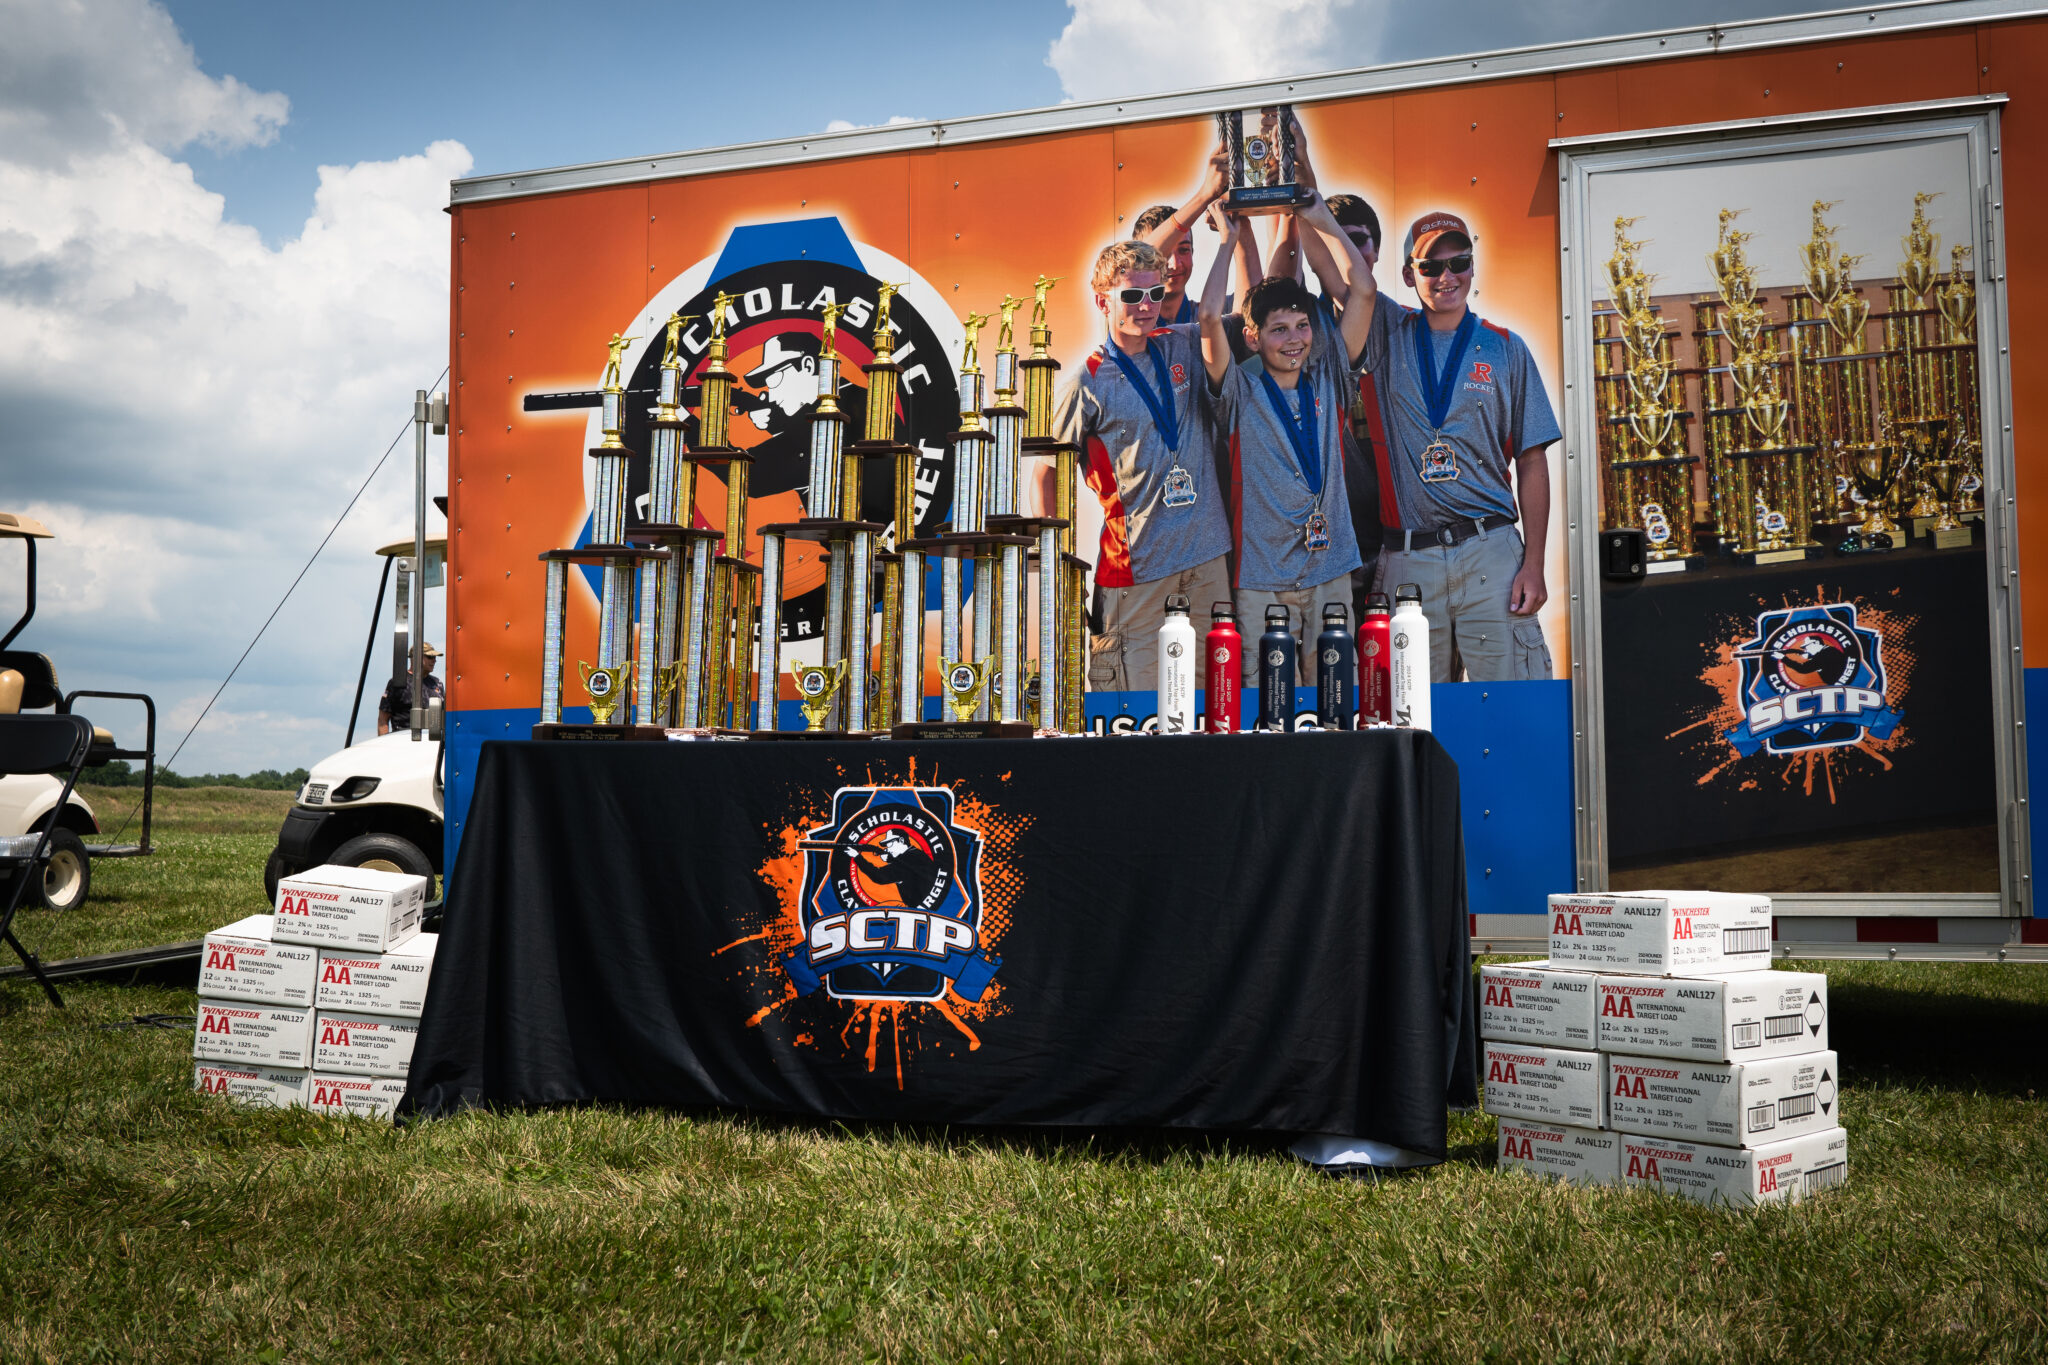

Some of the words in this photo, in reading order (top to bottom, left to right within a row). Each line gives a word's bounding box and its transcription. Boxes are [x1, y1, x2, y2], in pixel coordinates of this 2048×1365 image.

[1473, 362, 1492, 383] R
[1463, 382, 1495, 394] ROCKET
[1773, 624, 1852, 650] SCHOLASTIC
[1749, 687, 1882, 733] SCTP
[848, 811, 944, 854] SCHOLASTIC
[281, 888, 340, 902] WINCHESTER
[349, 896, 383, 906] AANL127
[278, 896, 309, 916] AA
[312, 905, 356, 914] INTERNATIONAL
[1551, 904, 1613, 915] WINCHESTER
[1624, 907, 1661, 916] AANL127
[1672, 906, 1710, 917] WINCHESTER
[311, 911, 331, 919] TARGET
[1552, 914, 1584, 936] AA
[1673, 917, 1693, 940] AA
[809, 910, 975, 961] SCTP
[207, 943, 267, 957] WINCHESTER
[276, 951, 310, 961] AANL127
[205, 951, 236, 971] AA
[238, 960, 283, 969] INTERNATIONAL
[322, 958, 381, 970] WINCHESTER
[237, 966, 258, 974] TARGET
[390, 964, 424, 973] AANL127
[321, 966, 351, 984] AA
[353, 973, 397, 982] INTERNATIONAL
[1483, 976, 1542, 989] WINCHESTER
[1552, 982, 1587, 992] AANL127
[1484, 985, 1514, 1008] AA
[1600, 985, 1665, 997] WINCHESTER
[1677, 989, 1715, 999] AANL127
[1515, 994, 1560, 1004] INTERNATIONAL
[1515, 1002, 1536, 1010] TARGET
[1601, 995, 1634, 1018] AA
[1636, 1004, 1686, 1012] INTERNATIONAL
[202, 1007, 261, 1020] WINCHESTER
[270, 1014, 304, 1023] AANL127
[1636, 1012, 1659, 1020] TARGET
[200, 1015, 231, 1034] AA
[233, 1023, 277, 1032] INTERNATIONAL
[321, 1020, 380, 1031] WINCHESTER
[389, 1025, 418, 1033] AANL12
[1601, 1023, 1610, 1031] 12
[320, 1027, 350, 1046] AA
[352, 1035, 397, 1043] INTERNATIONAL
[1487, 1051, 1546, 1067] WINCHESTER
[1556, 1060, 1591, 1071] AANL127
[200, 1068, 259, 1080] WINCHESTER
[1488, 1061, 1518, 1084] AA
[1519, 1071, 1564, 1082] INTERNATIONAL
[1613, 1064, 1680, 1080] WINCHESTER
[1691, 1072, 1731, 1084] AANL127
[268, 1075, 304, 1084] AANL127
[314, 1079, 372, 1091] WINCHESTER
[1519, 1079, 1540, 1088] TARGET
[382, 1085, 406, 1094] AANL1
[1613, 1075, 1648, 1099] AA
[1650, 1085, 1701, 1096] INTERNATIONAL
[312, 1087, 342, 1106] AA
[1650, 1093, 1673, 1102] TARGET
[1675, 1096, 1692, 1104] LOAD
[1613, 1102, 1623, 1111] 12
[1657, 1109, 1673, 1117] 1325
[1502, 1127, 1564, 1143] WINCHESTER
[1502, 1136, 1534, 1160] AA
[1575, 1137, 1612, 1149] AANL127
[1624, 1145, 1693, 1163] WINCHESTER
[1705, 1156, 1746, 1169] AANL127
[1758, 1153, 1792, 1170] WINCHESTER
[1625, 1155, 1661, 1181] AA
[1759, 1168, 1777, 1194] AA
